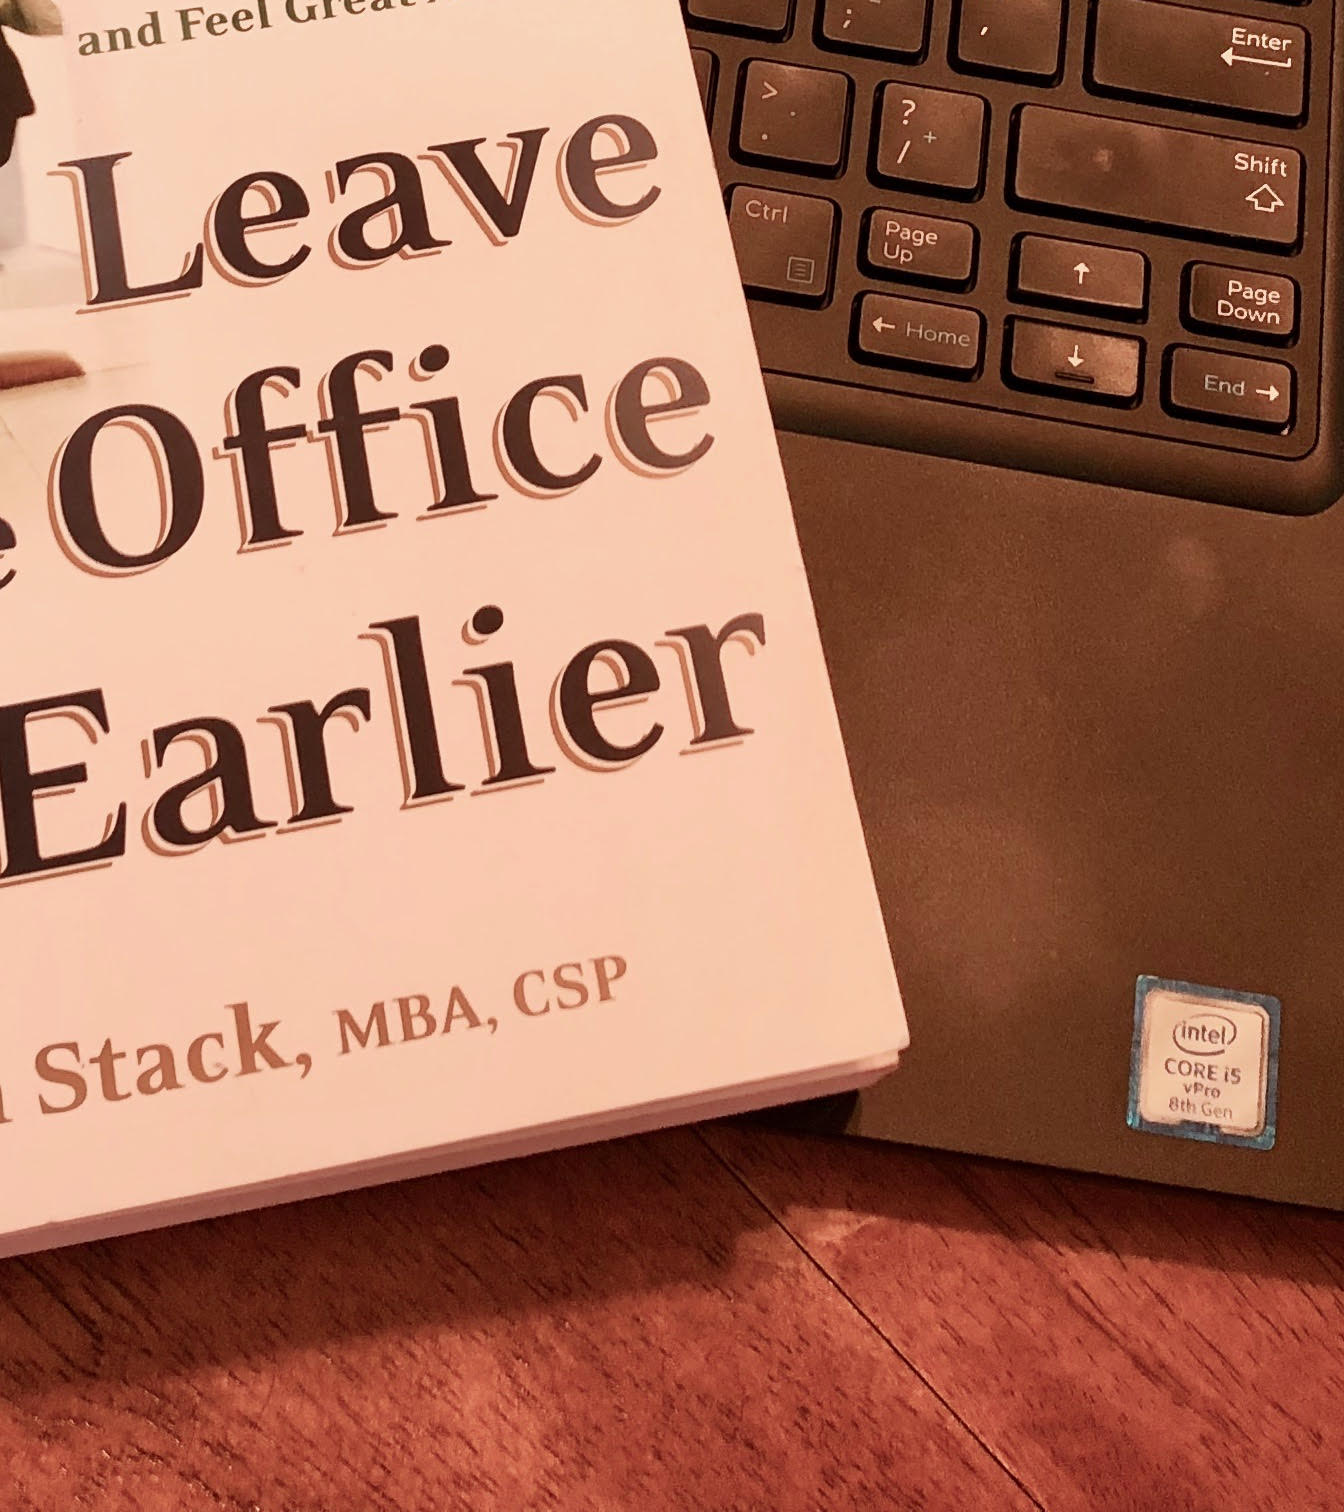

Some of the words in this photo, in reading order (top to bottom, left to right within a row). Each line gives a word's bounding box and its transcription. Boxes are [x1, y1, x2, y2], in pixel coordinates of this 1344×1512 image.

[76, 11, 166, 56] and
[1231, 27, 1292, 52] Enter
[901, 99, 916, 125] ?
[1234, 152, 1288, 178] Shift
[47, 112, 665, 316] Leave
[745, 199, 789, 225] Ctrl
[884, 220, 938, 247] Page
[883, 242, 914, 264] Up
[1227, 280, 1281, 306] Page
[1217, 299, 1281, 325] Down
[905, 321, 971, 348] Home
[1204, 374, 1245, 396] End
[47, 343, 717, 580] Office
[33, 1000, 315, 1116] Stack,
[333, 983, 499, 1057] MBA,
[511, 953, 630, 1019] CSP
[1180, 1021, 1225, 1045] intel
[1164, 1057, 1217, 1082] CORE
[1224, 1067, 1242, 1085] i5
[1183, 1082, 1221, 1099] vPro
[1168, 1096, 1196, 1114] 8th
[1201, 1102, 1233, 1120] Gen
